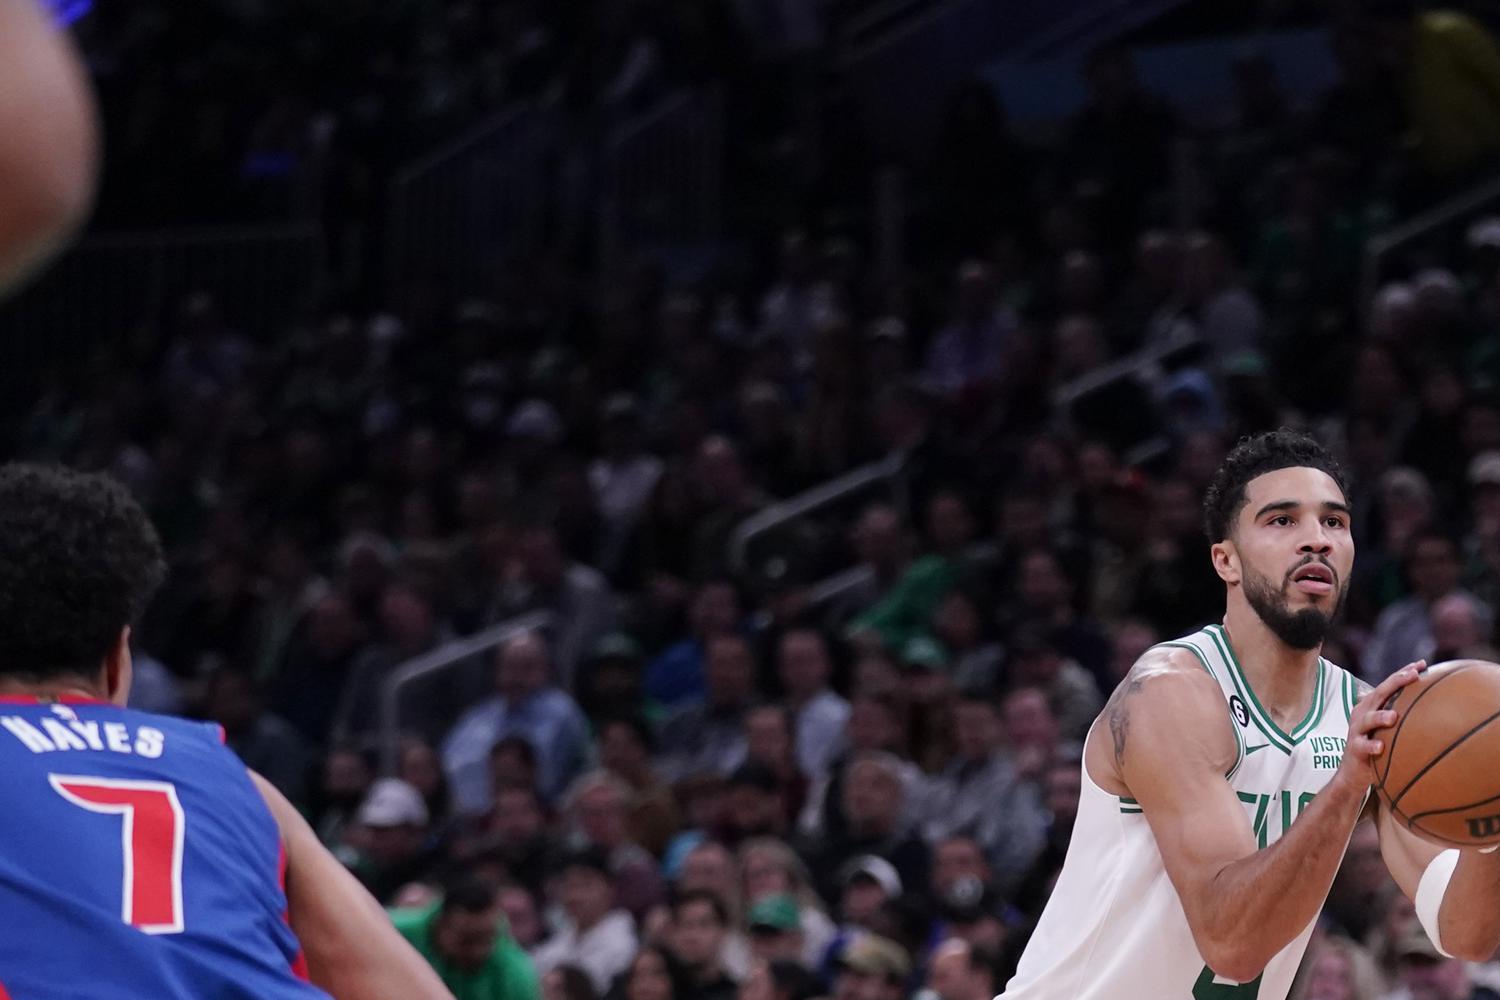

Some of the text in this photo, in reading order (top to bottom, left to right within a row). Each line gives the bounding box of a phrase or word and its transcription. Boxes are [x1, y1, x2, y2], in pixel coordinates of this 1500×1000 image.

[1232, 699, 1247, 725] 6
[0, 714, 165, 759] HAYES
[1313, 755, 1342, 769] PRIN
[48, 772, 186, 936] 7
